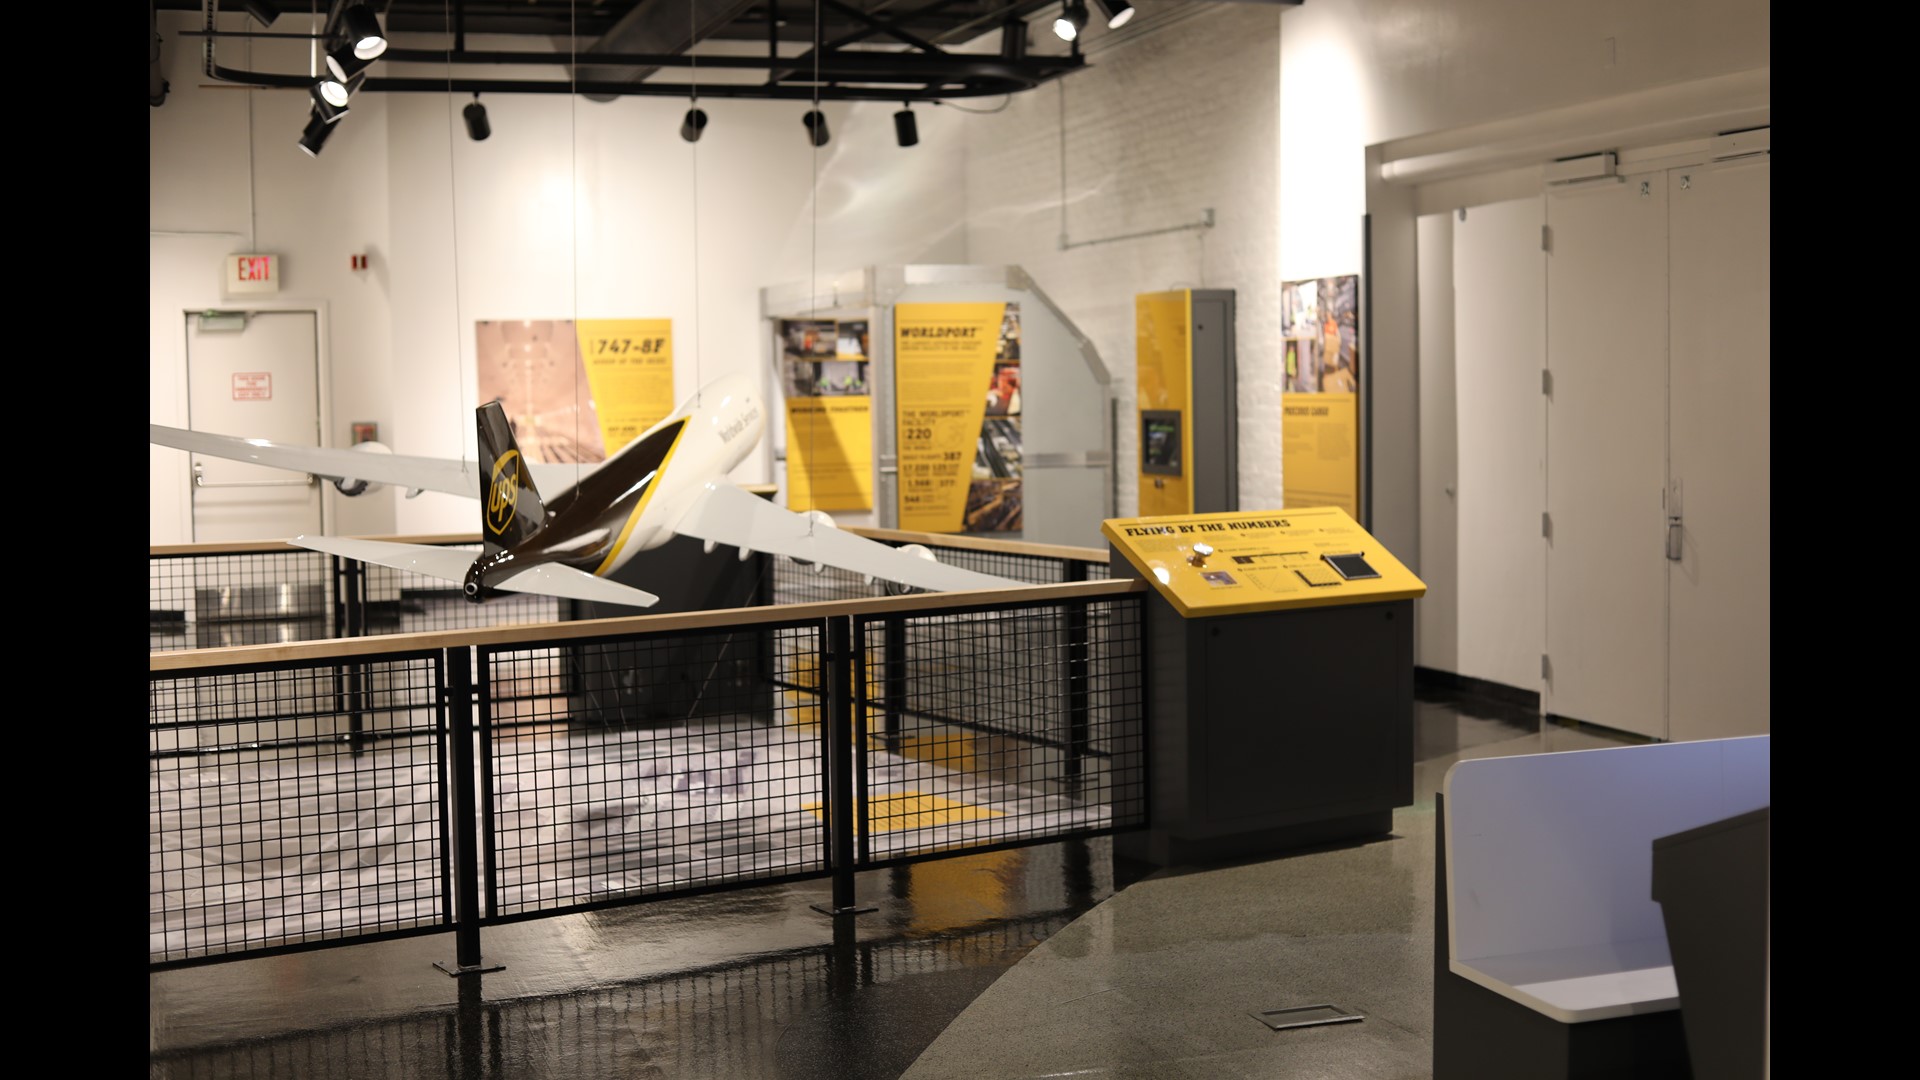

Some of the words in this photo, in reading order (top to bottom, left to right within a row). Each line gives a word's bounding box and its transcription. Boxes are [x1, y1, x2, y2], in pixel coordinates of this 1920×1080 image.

[238, 256, 270, 281] EXIT
[901, 327, 976, 338] WORLDPORT
[598, 338, 665, 354] 747-8F
[907, 428, 932, 439] 220
[1125, 525, 1175, 536] FLYING
[1178, 525, 1194, 533] BY
[1198, 523, 1225, 532] THE
[1228, 519, 1291, 530] NUMBERS
